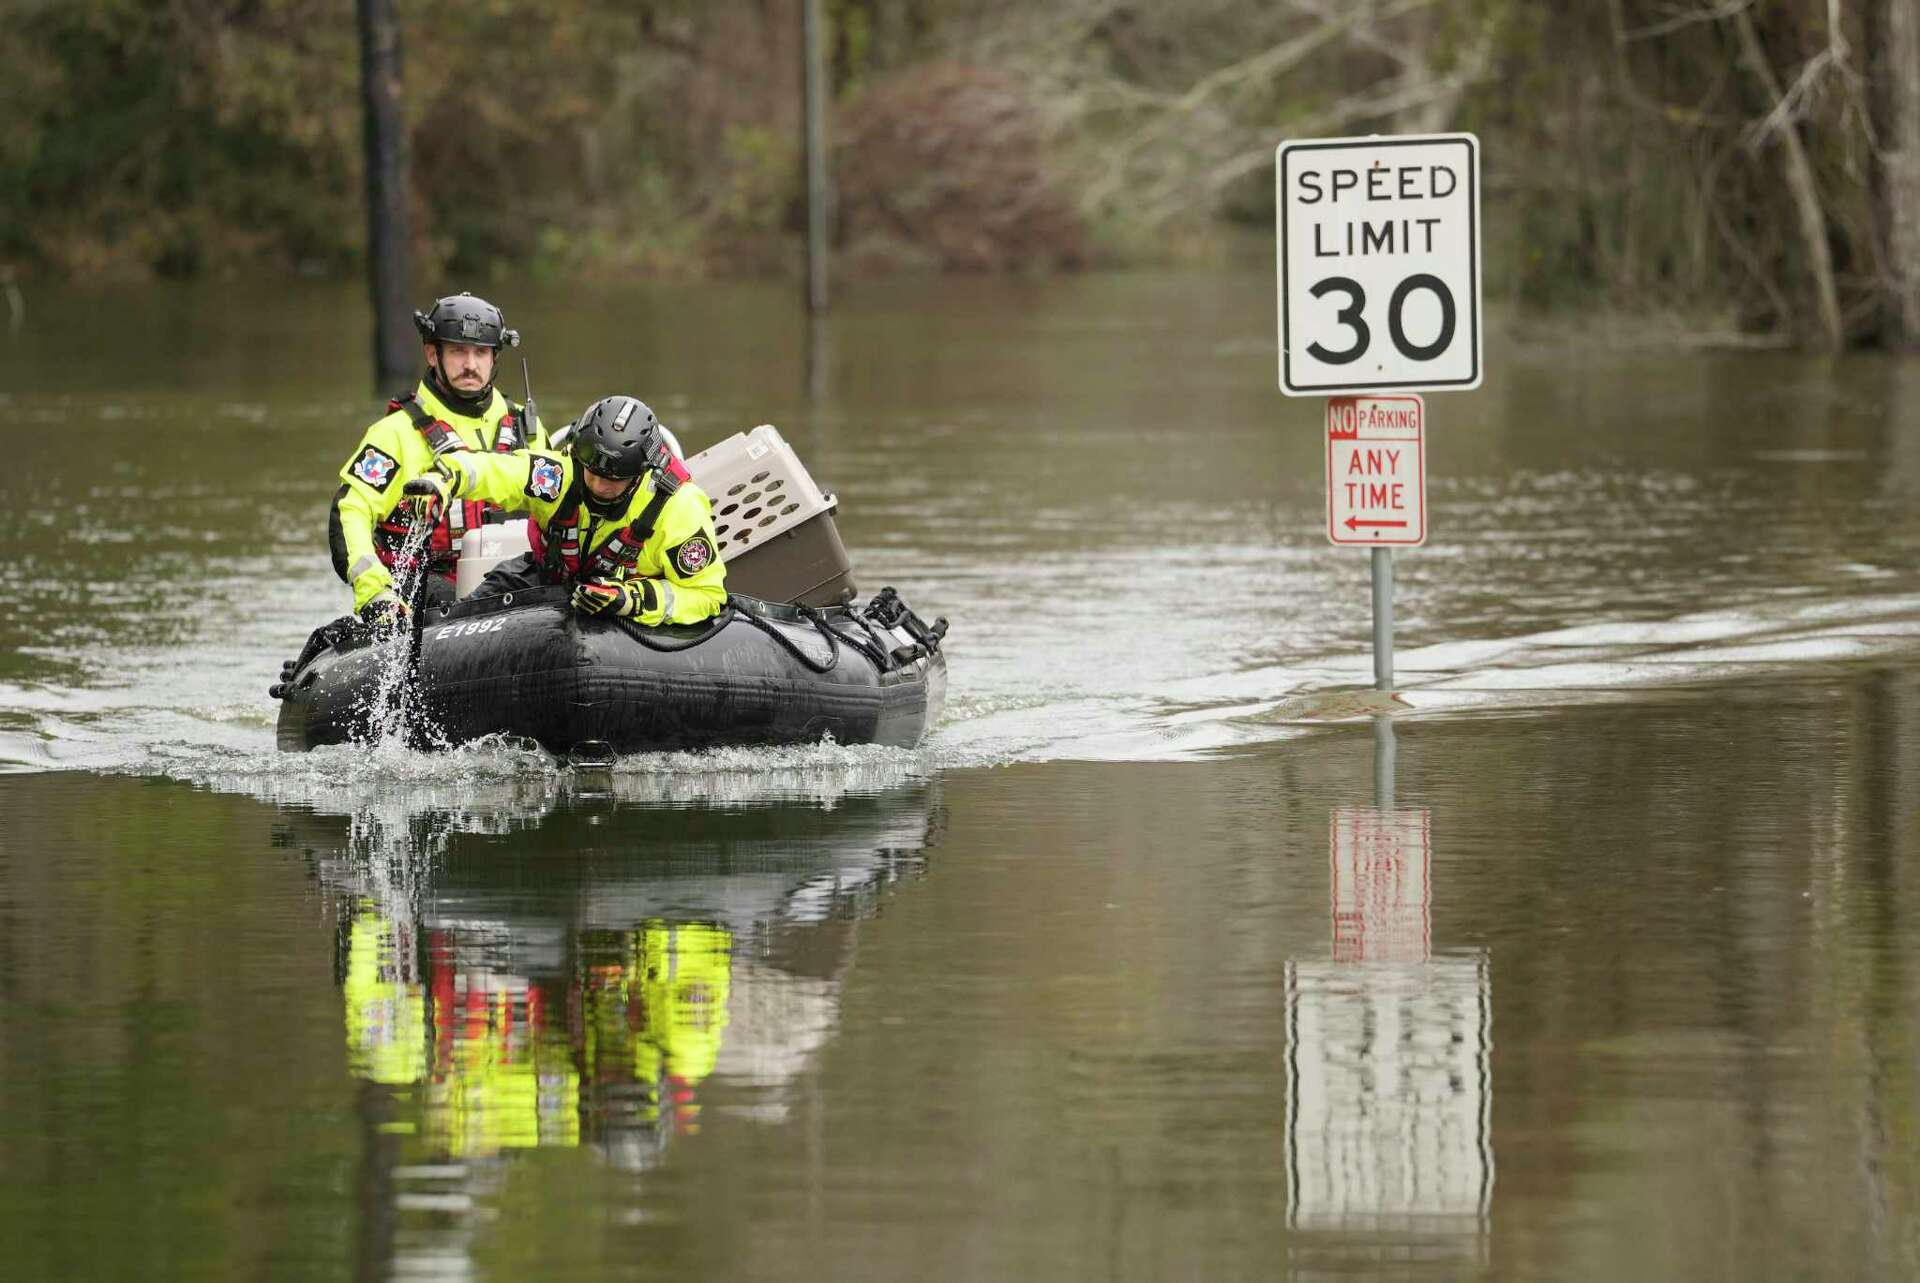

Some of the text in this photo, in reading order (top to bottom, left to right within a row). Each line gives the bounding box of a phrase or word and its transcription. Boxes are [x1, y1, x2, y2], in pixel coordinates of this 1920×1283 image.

[1297, 165, 1457, 204] SPEED
[1314, 218, 1441, 257] LIMIT
[1305, 273, 1456, 365] 30
[1330, 405, 1416, 433] NO PARKING
[1348, 448, 1401, 475] ANY
[1344, 482, 1406, 510] TIME
[435, 617, 506, 640] E1992
